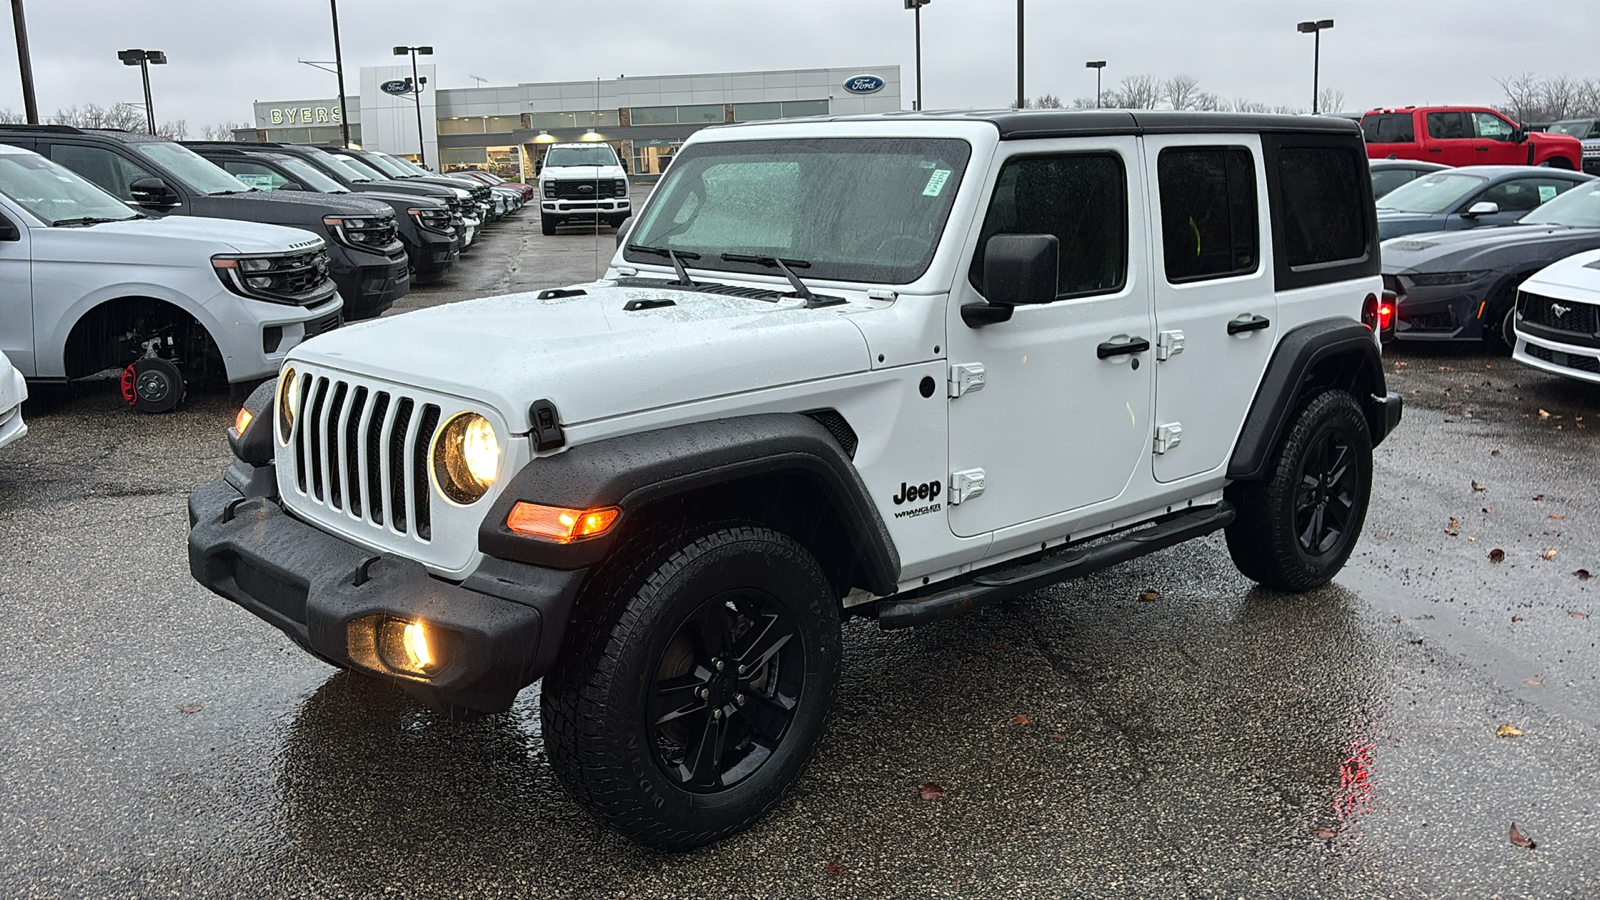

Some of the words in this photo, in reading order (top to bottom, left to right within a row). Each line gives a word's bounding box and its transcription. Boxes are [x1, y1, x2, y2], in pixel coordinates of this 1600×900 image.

[386, 82, 405, 91] Ford
[852, 79, 876, 90] Ford
[270, 106, 340, 124] BYERS
[893, 480, 941, 505] Jeep
[894, 503, 941, 519] WRANGLER
